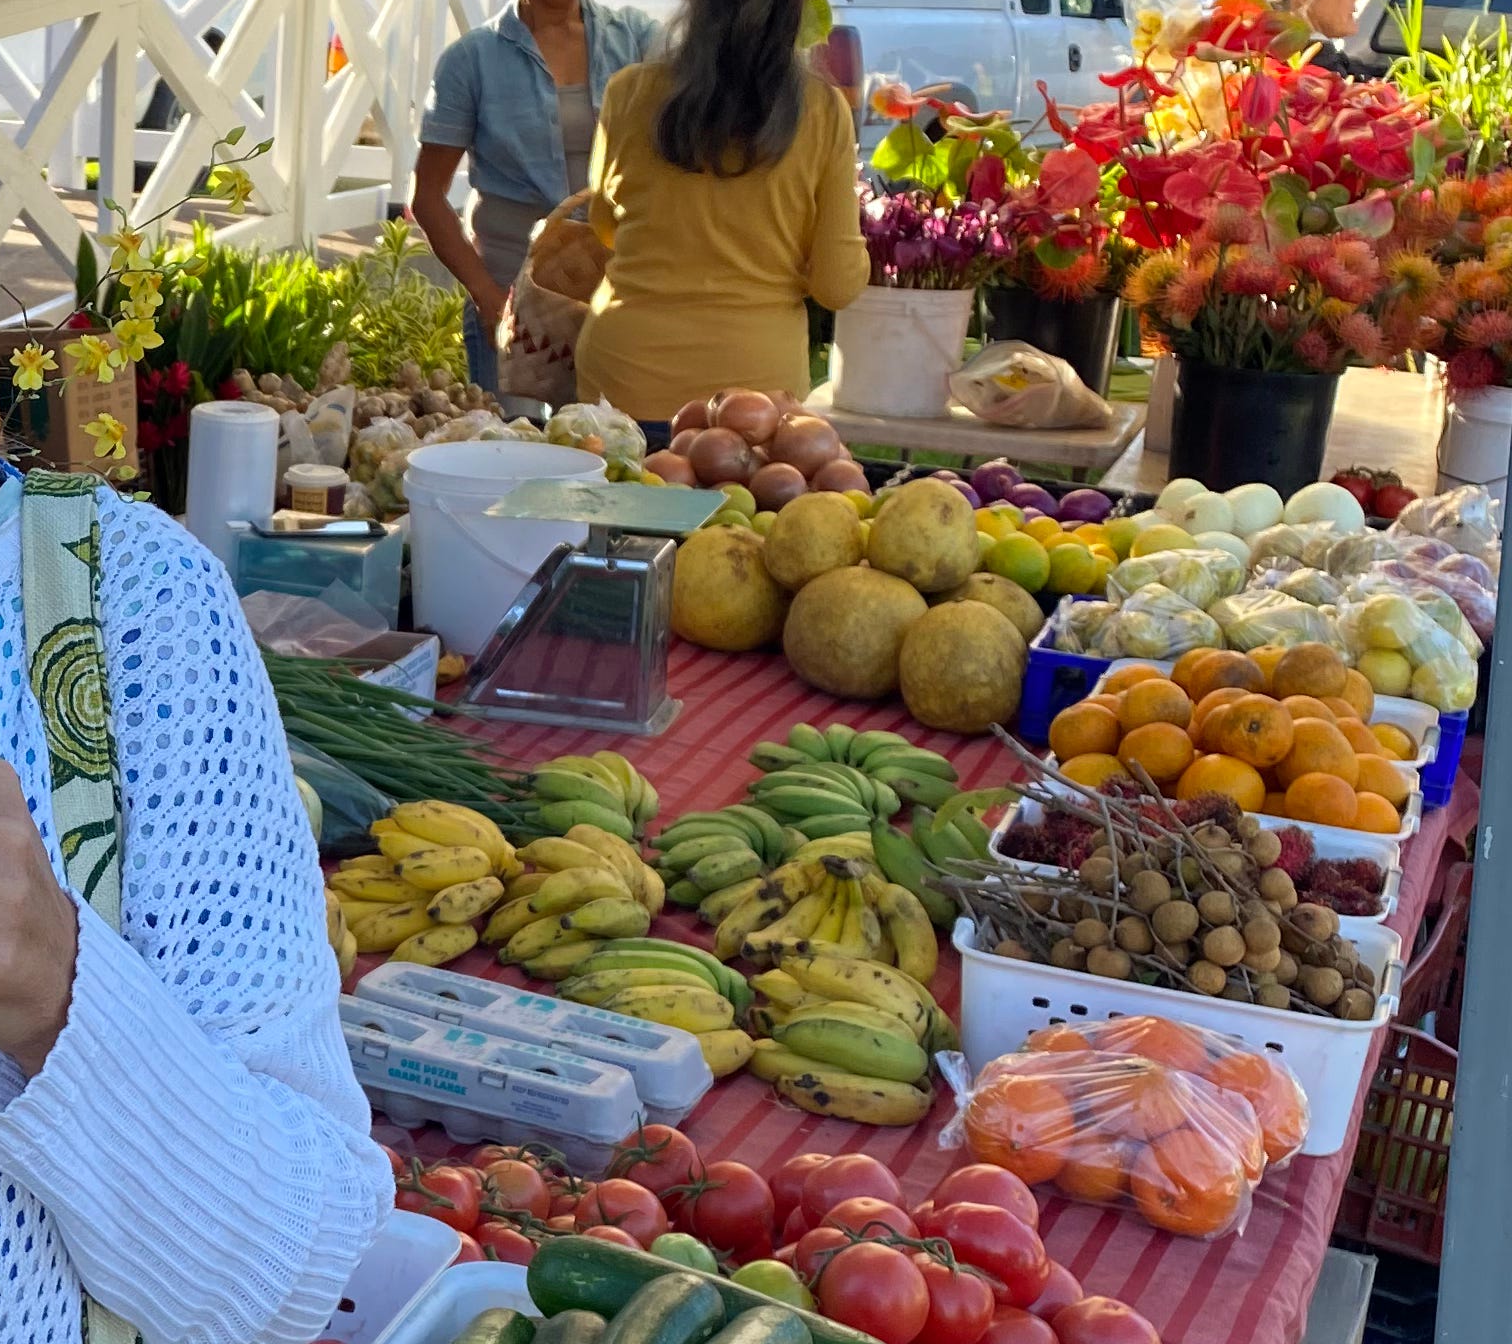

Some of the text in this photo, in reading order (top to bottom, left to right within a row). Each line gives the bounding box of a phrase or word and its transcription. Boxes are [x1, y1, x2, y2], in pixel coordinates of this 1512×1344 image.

[514, 994, 559, 1014] 12
[442, 1027, 488, 1048] 12
[400, 1058, 459, 1082] ONE DOZEN
[388, 1067, 422, 1086] GRADE
[433, 1079, 469, 1096] LARGE
